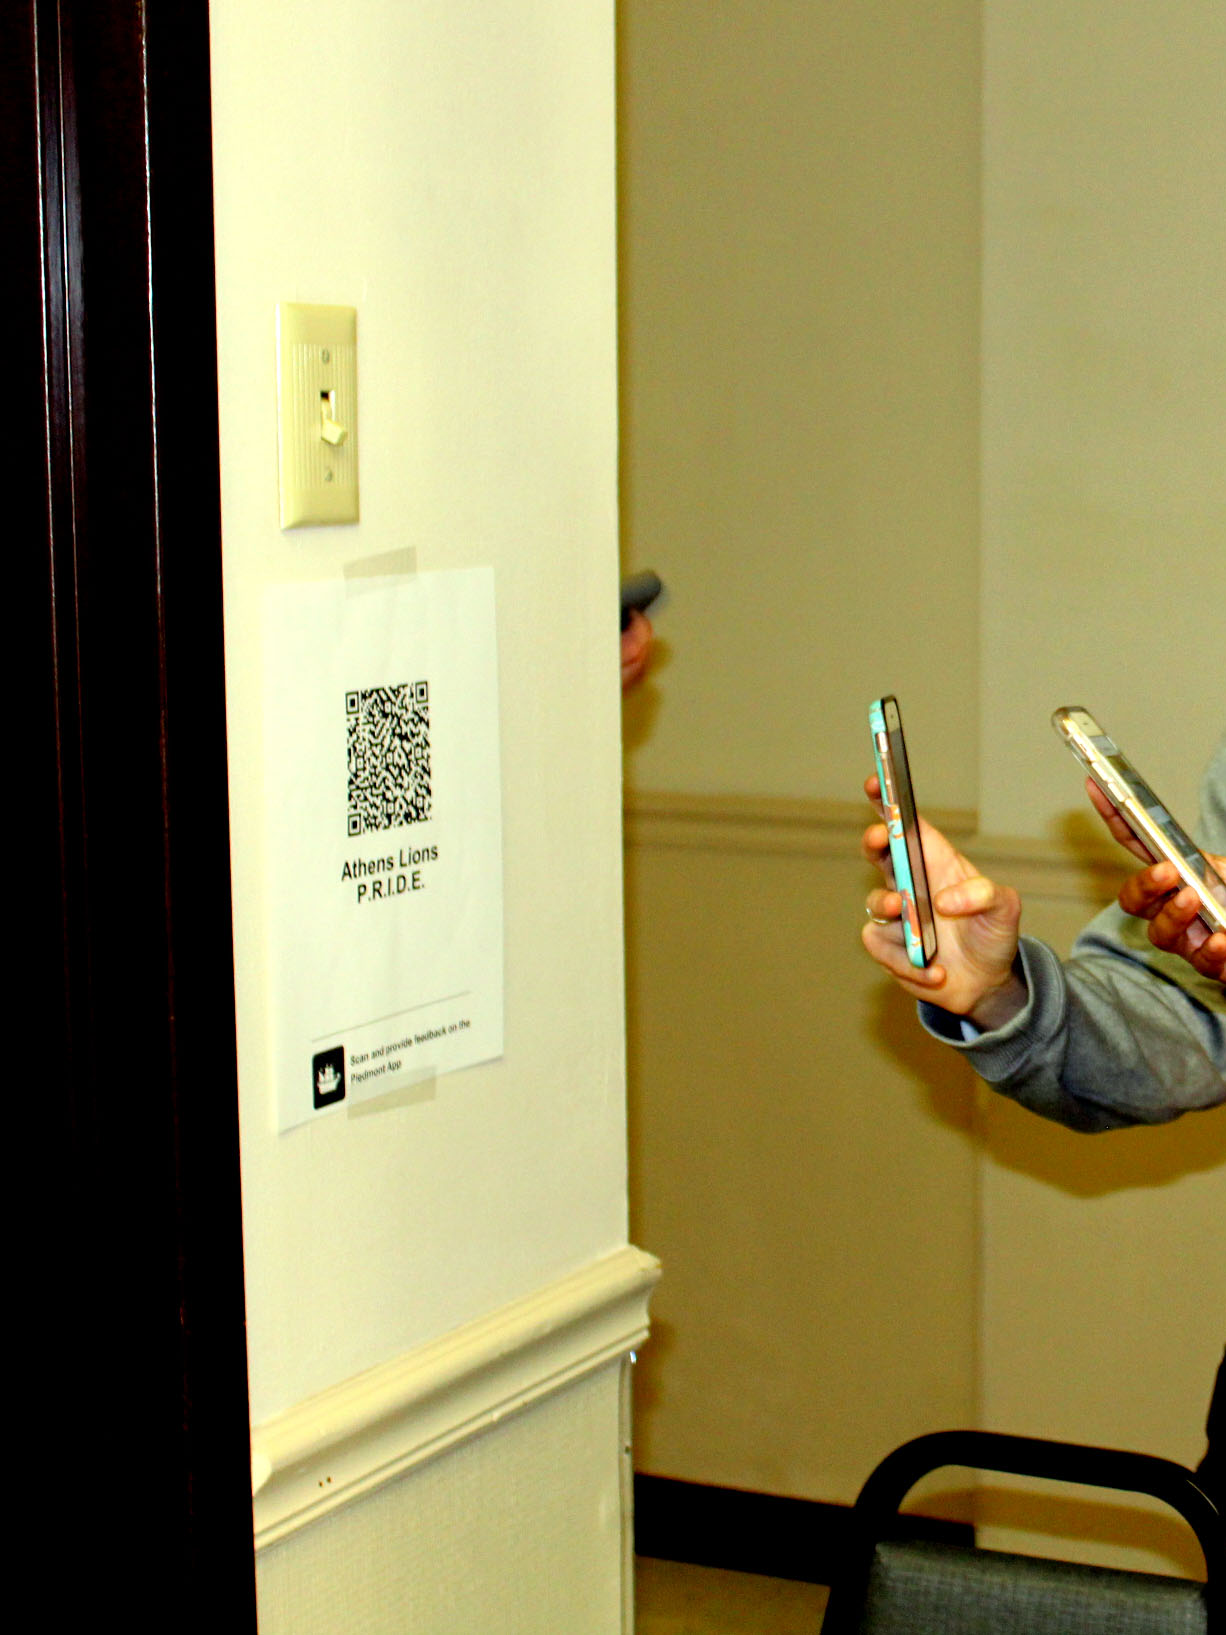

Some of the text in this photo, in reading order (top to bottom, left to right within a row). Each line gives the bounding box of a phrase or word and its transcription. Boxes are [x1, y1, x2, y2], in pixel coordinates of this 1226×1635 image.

[341, 845, 439, 881] Athens Lions
[357, 870, 425, 904] P.R.I.D.E.
[350, 1019, 471, 1066] Scan and provide feedback on the
[350, 1059, 402, 1084] Piedmont App
